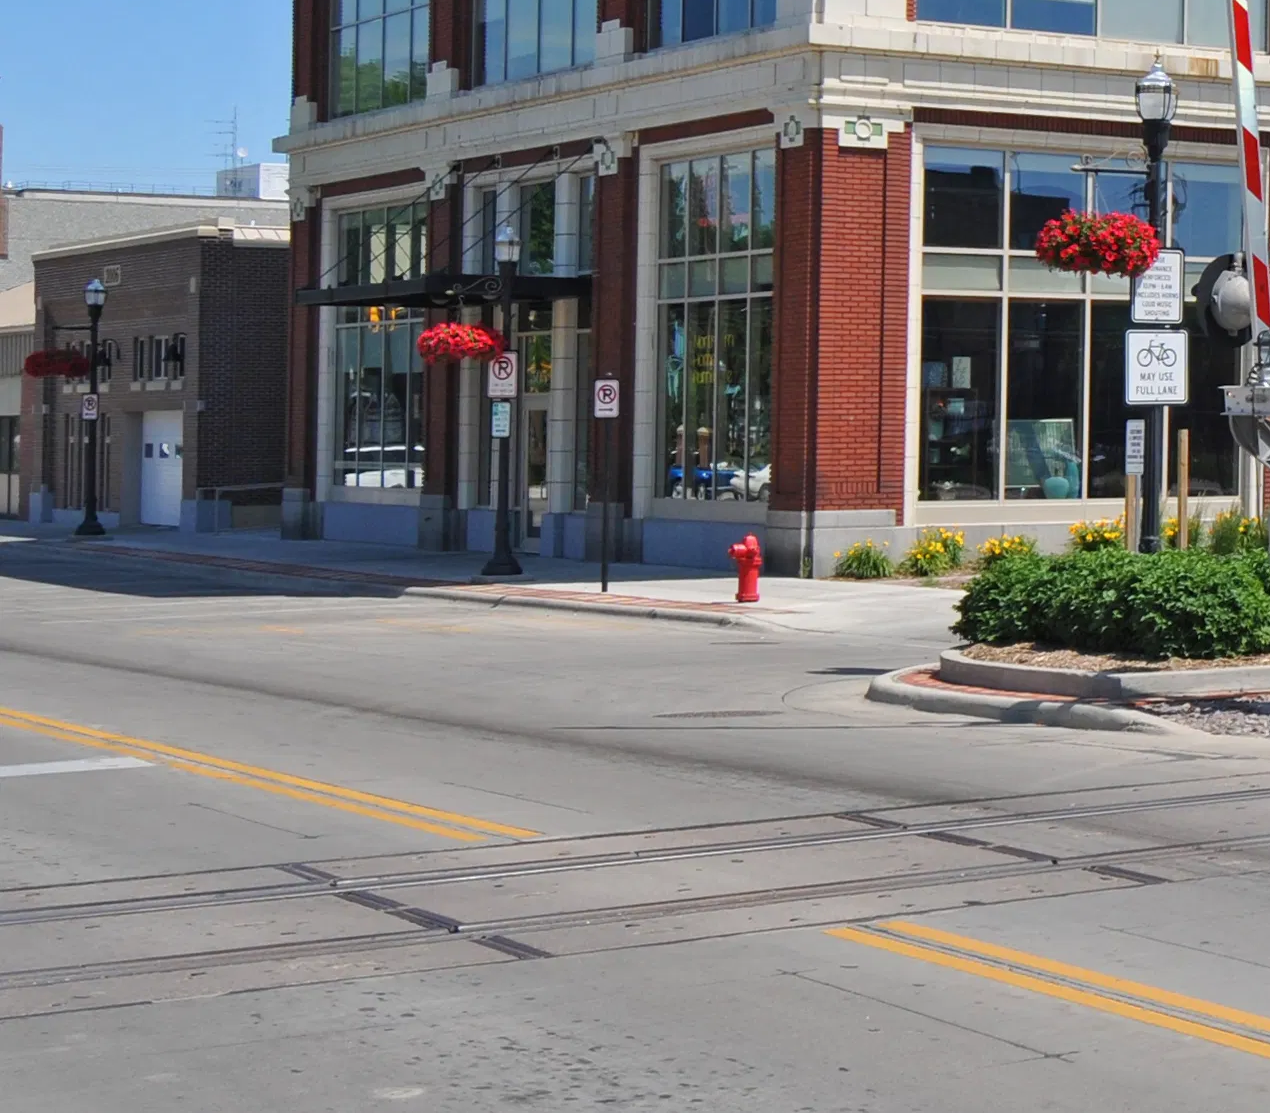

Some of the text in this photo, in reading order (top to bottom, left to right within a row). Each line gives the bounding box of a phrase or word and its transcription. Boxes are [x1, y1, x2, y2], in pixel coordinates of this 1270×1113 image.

[1140, 372, 1174, 381] MAY USE
[1135, 386, 1179, 395] FULL LANE
